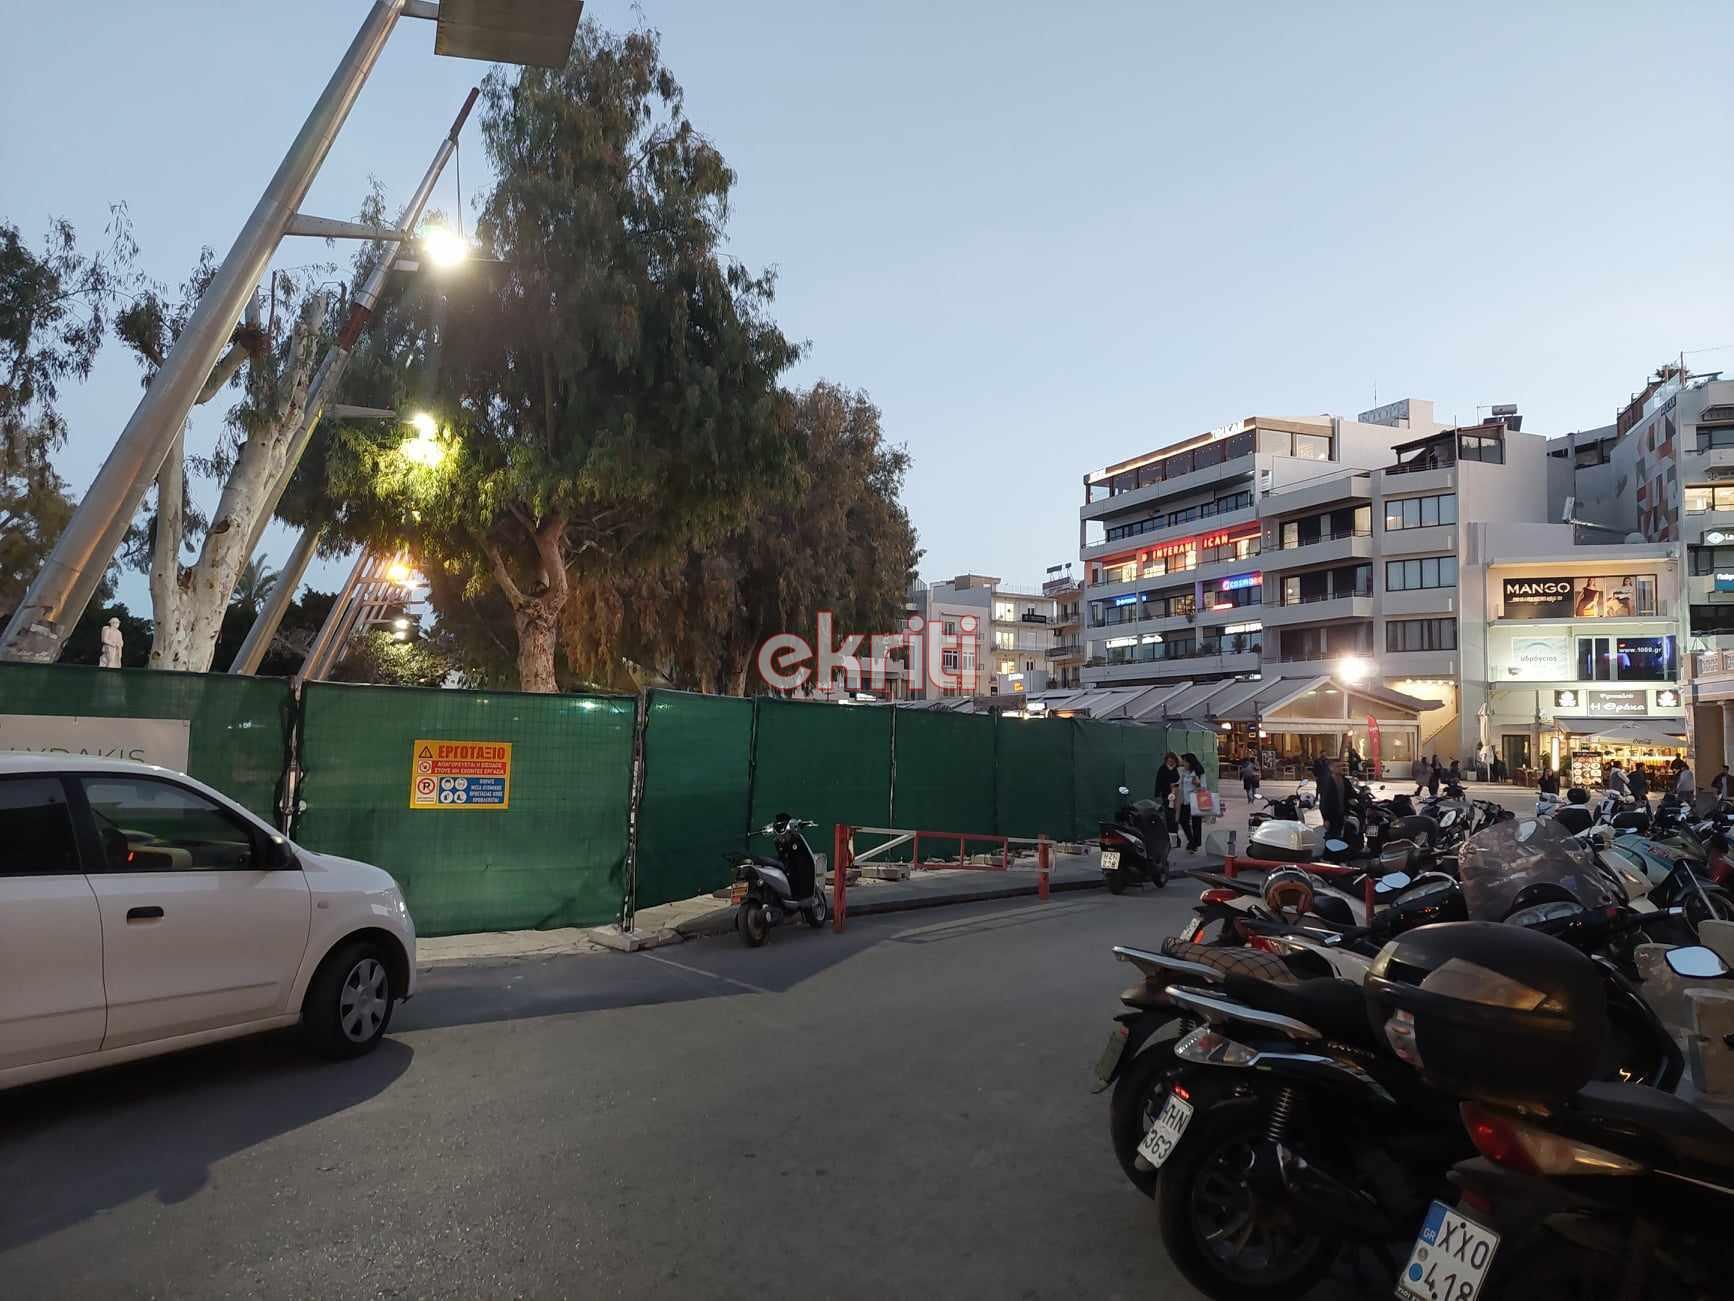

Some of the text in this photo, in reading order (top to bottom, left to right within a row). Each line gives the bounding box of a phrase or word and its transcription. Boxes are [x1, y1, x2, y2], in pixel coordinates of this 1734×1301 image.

[1152, 536, 1228, 560] INTERAMEICAN
[1506, 582, 1571, 595] MANGO
[438, 744, 506, 760] ΕΡΓΟΤΑΞΙΟ
[1143, 1128, 1173, 1159] 363
[1423, 1227, 1436, 1242] GR
